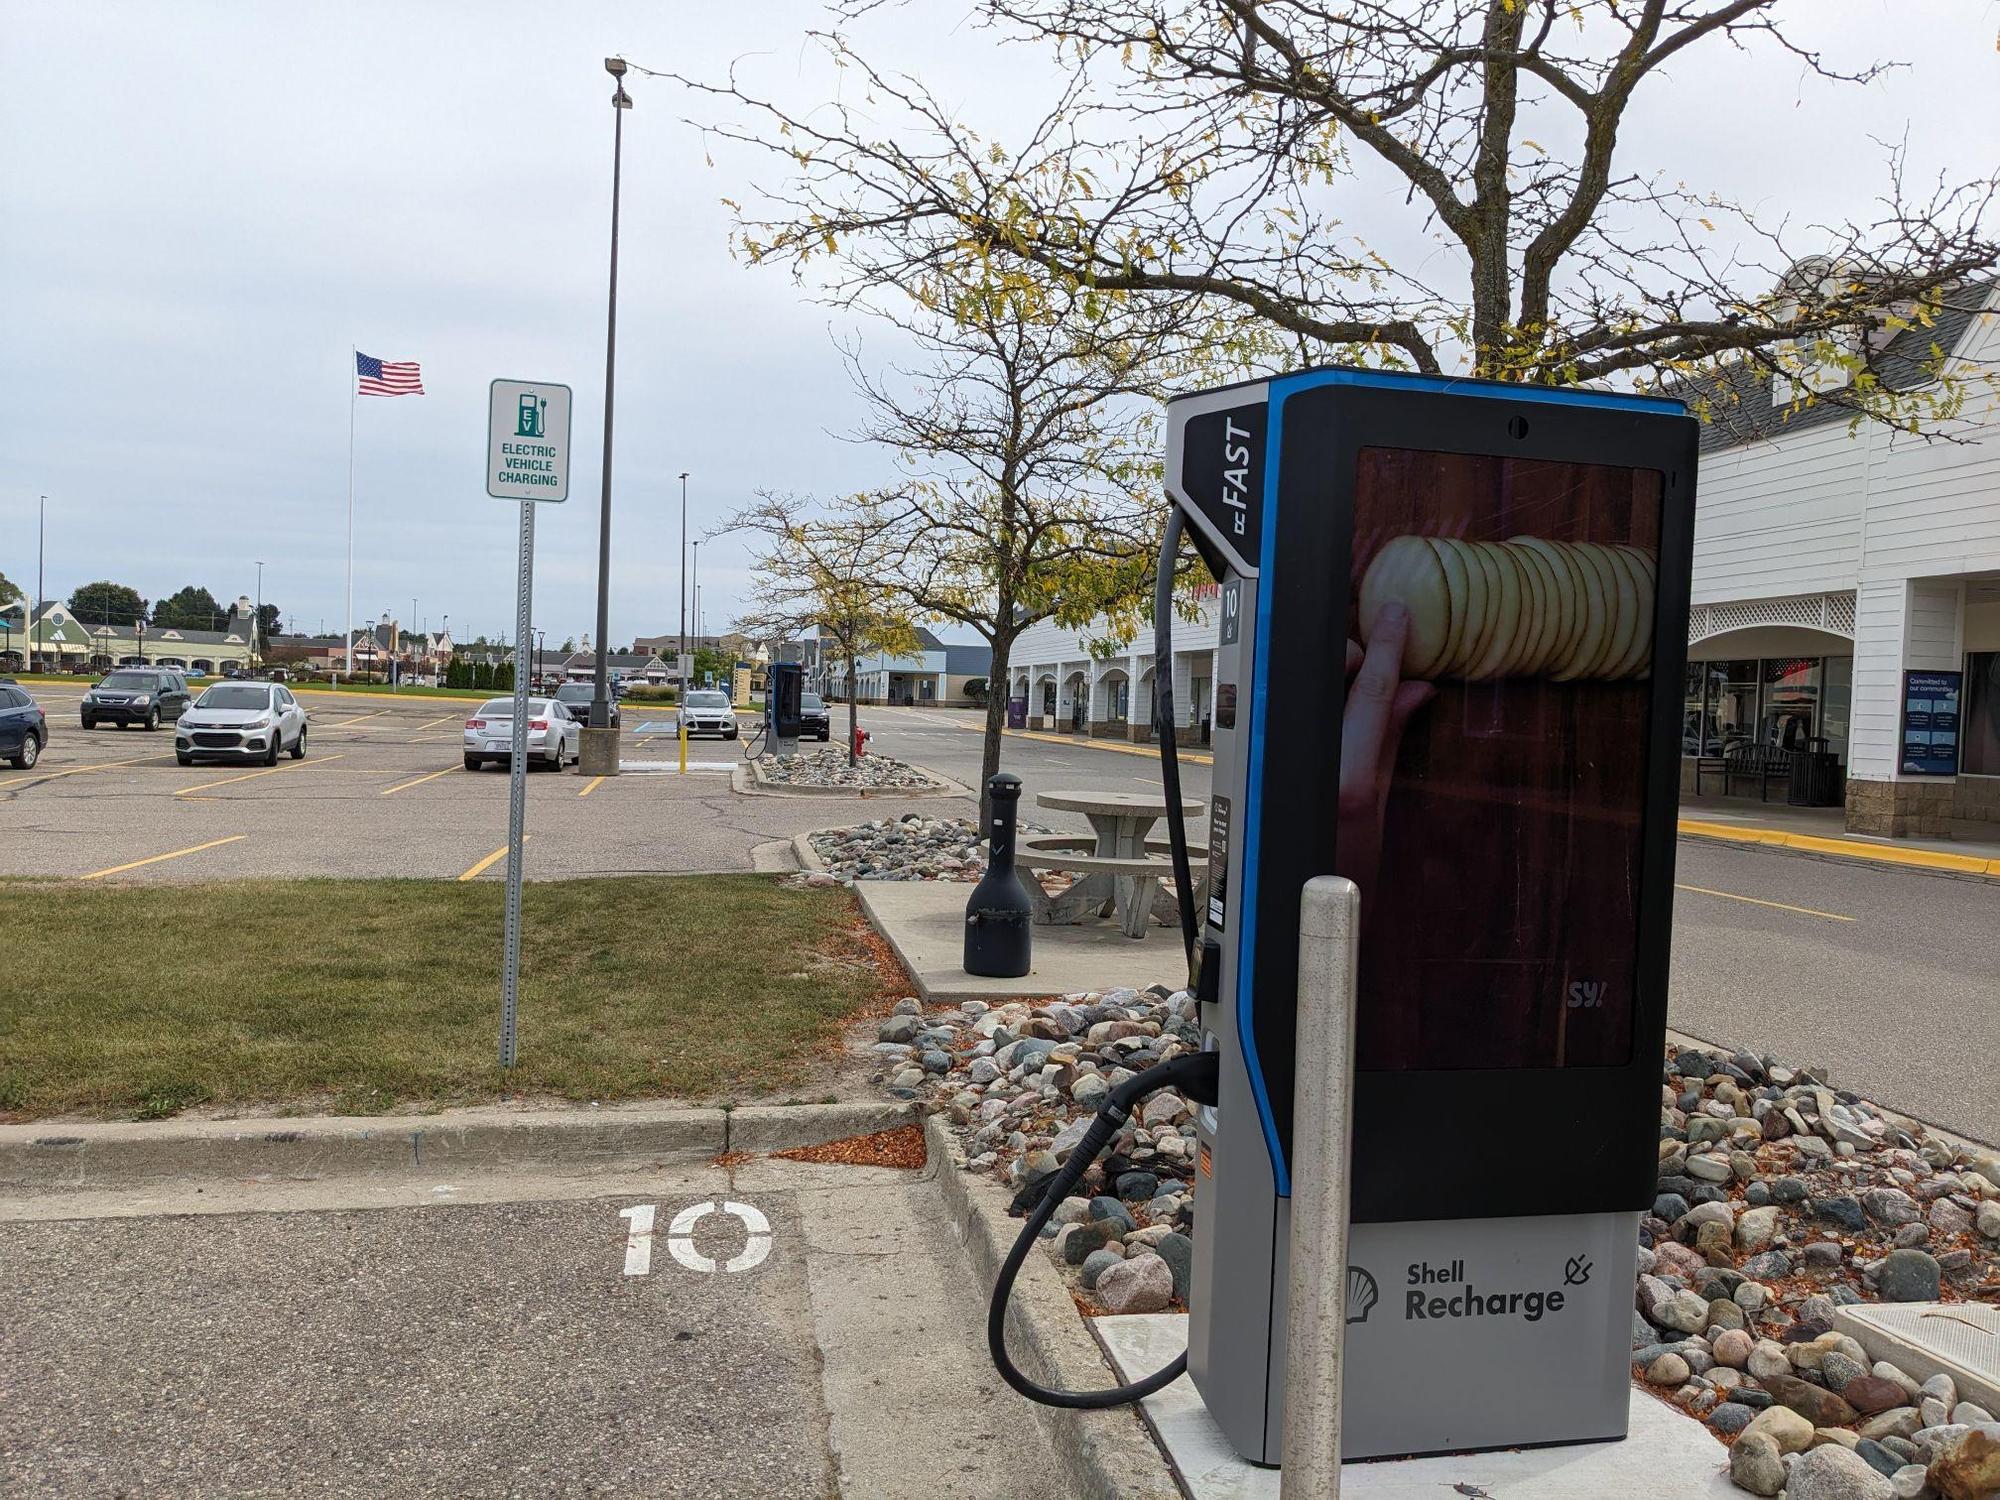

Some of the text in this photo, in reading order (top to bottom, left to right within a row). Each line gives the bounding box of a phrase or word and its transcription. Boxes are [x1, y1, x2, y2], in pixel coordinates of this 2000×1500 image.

[502, 443, 556, 458] ELECTRIC
[1222, 416, 1250, 510] FAST
[505, 458, 552, 471] VEHICLE
[498, 472, 558, 486] CHARGING
[1226, 588, 1237, 618] 10
[619, 1201, 773, 1276] 10
[1407, 1260, 1464, 1284] Shell
[1405, 1285, 1565, 1322] Recharge
